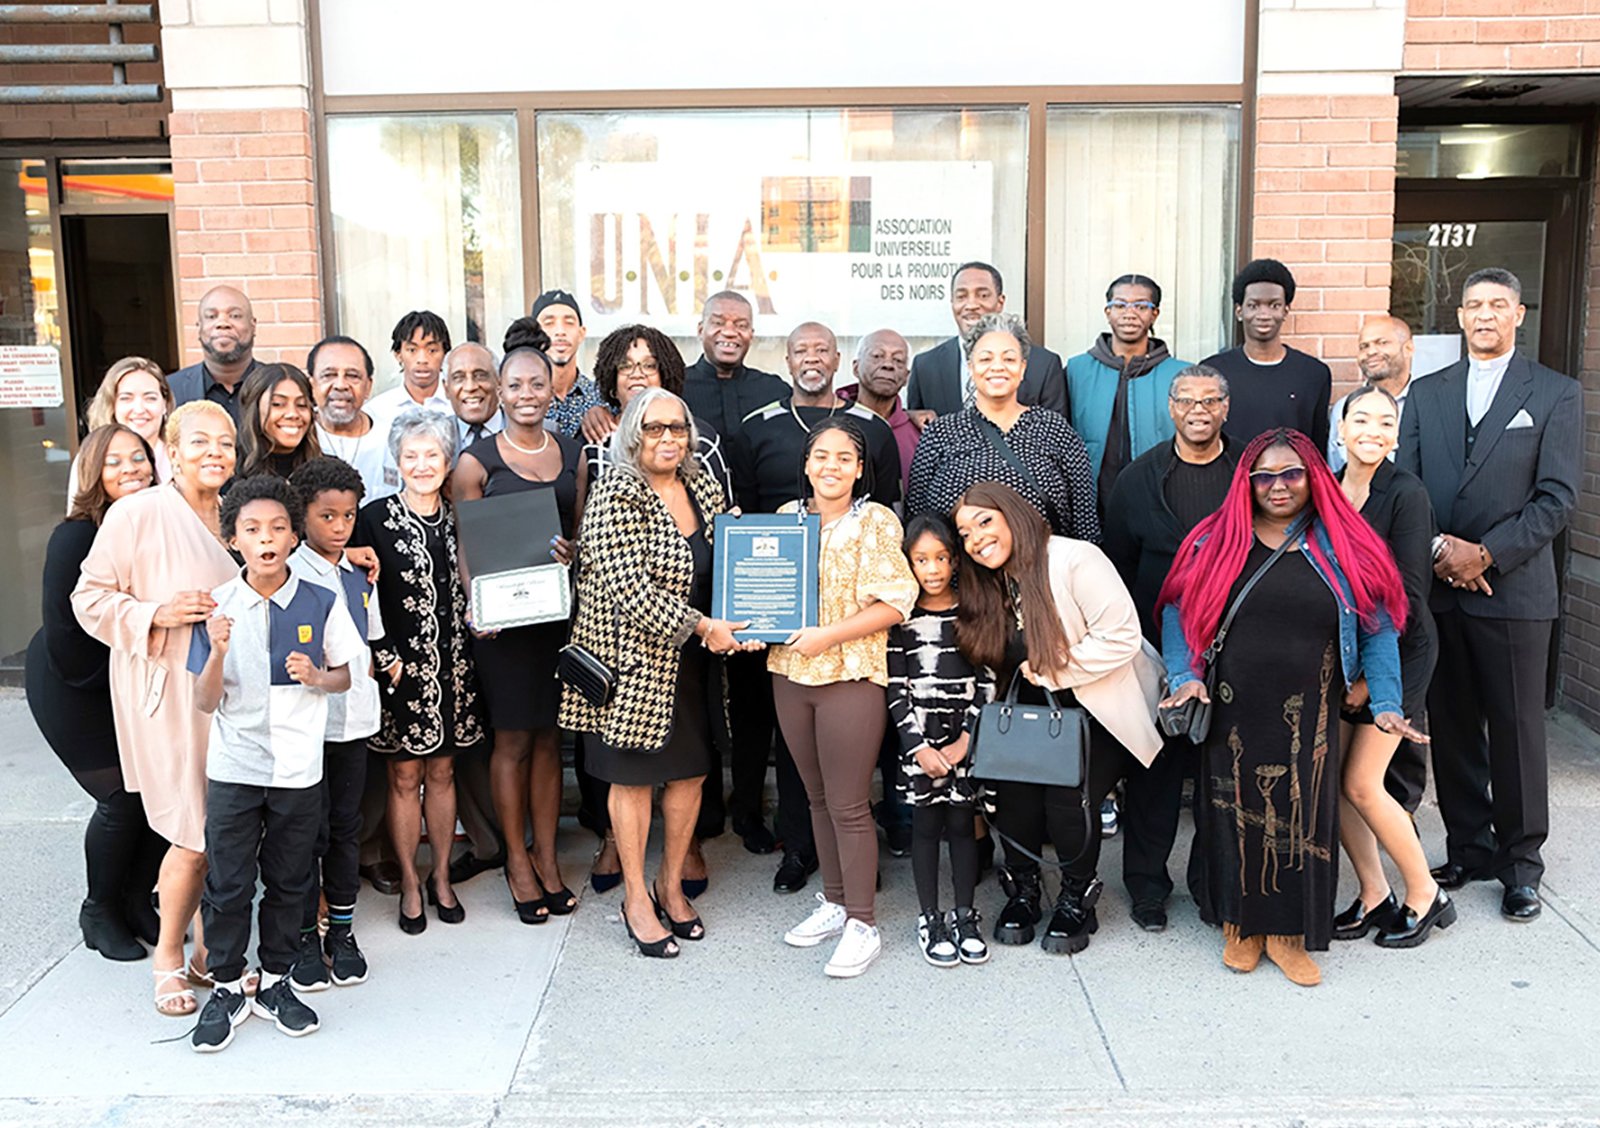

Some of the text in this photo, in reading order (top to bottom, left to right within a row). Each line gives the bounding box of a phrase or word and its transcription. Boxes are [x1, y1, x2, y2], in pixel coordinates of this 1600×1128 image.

[875, 219, 952, 235] ASSOCIATION
[1428, 223, 1477, 247] 2737
[875, 240, 951, 256] UNIVERSELLE
[851, 262, 883, 278] POUR
[888, 262, 903, 278] LA
[880, 284, 945, 300] DES NOIRS
